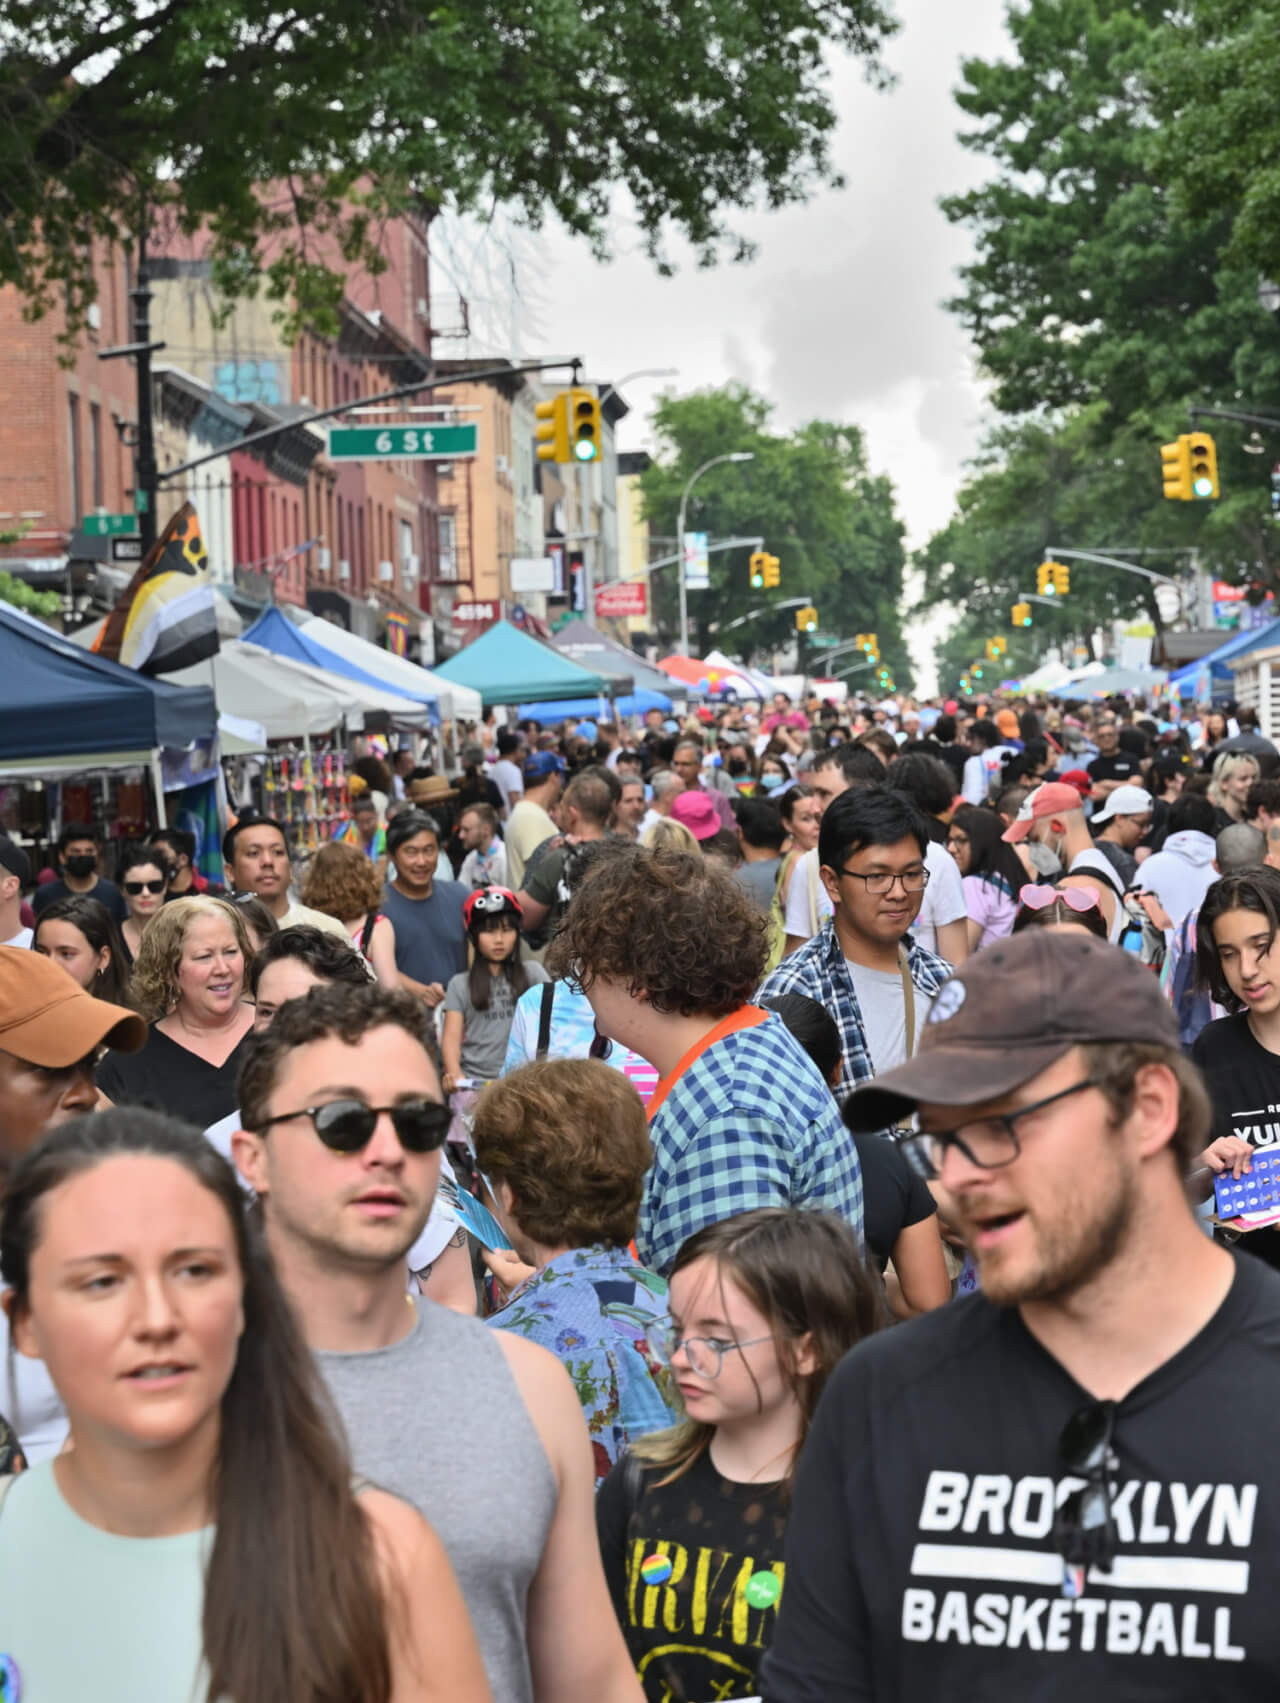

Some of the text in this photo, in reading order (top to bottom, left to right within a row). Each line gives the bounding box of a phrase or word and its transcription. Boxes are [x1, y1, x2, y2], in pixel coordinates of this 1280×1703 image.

[375, 430, 434, 453] 6 St
[625, 1537, 787, 1648] IRVAN
[901, 1588, 1247, 1662] BASKETBALL
